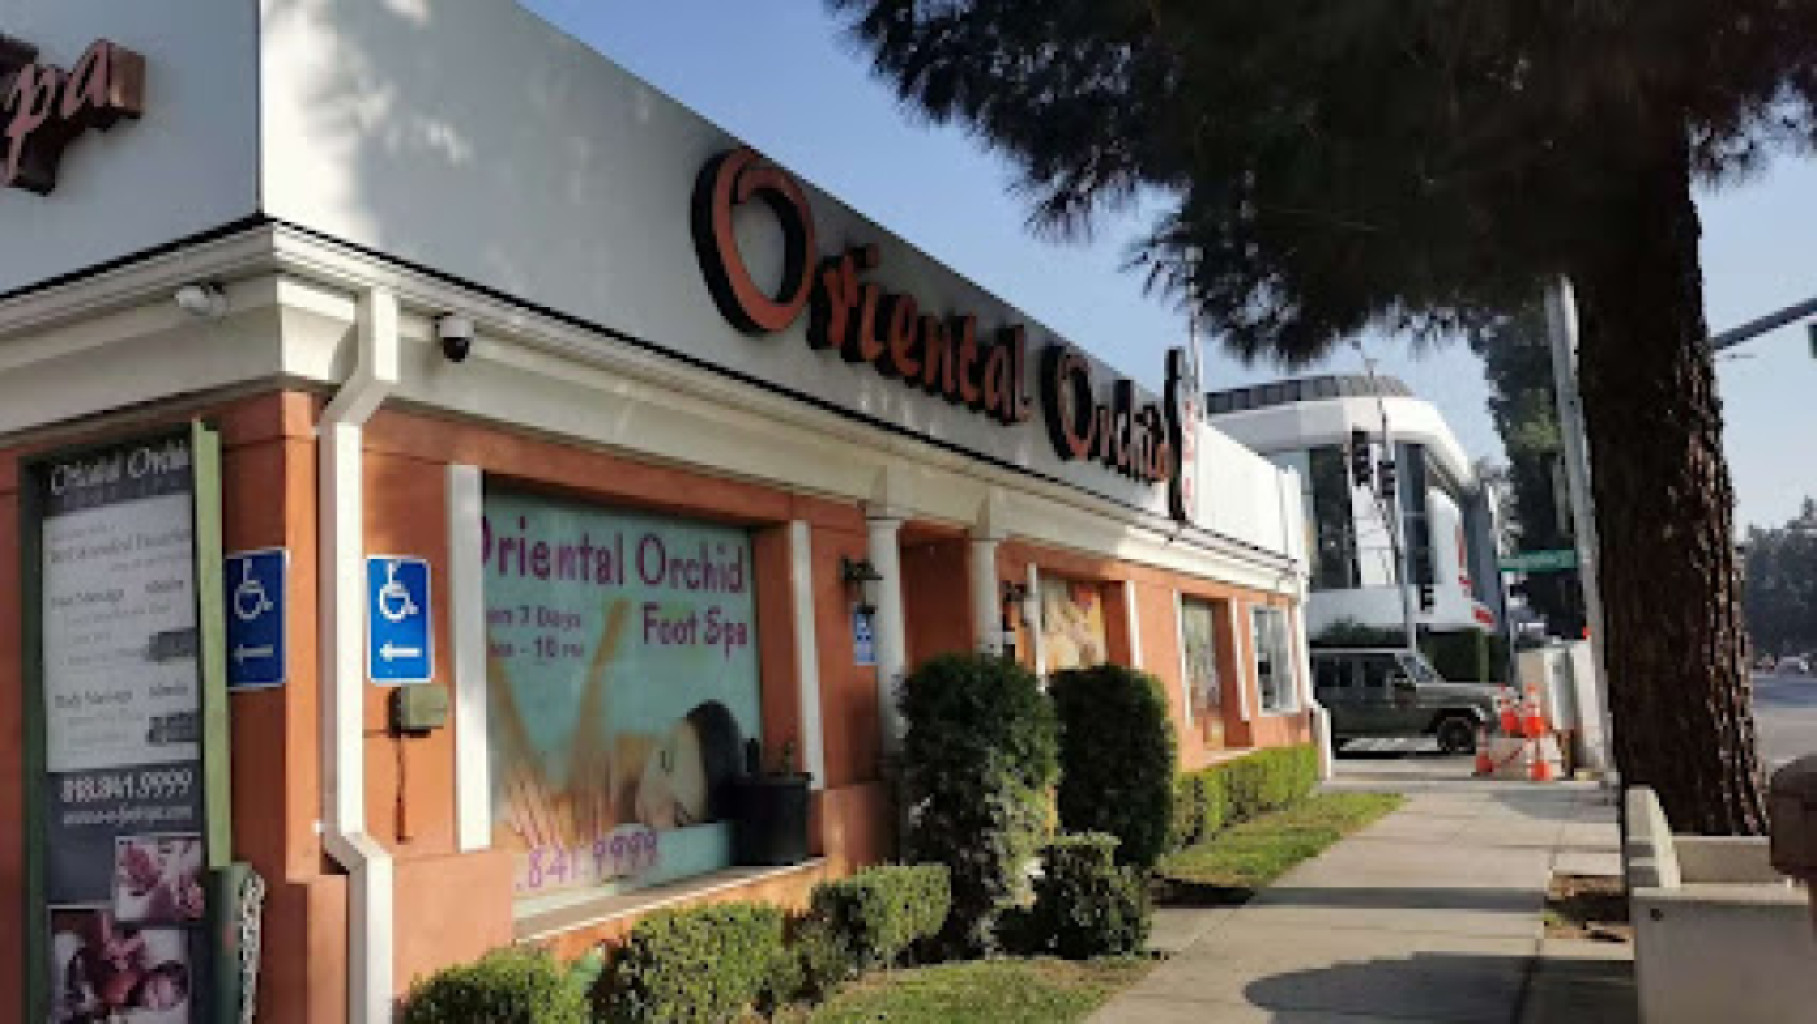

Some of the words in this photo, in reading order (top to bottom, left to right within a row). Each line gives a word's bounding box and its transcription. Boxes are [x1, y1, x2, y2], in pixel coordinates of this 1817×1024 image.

[0, 37, 146, 195] pa
[692, 147, 1033, 426] Oriental
[1040, 344, 1175, 488] Orchid
[635, 532, 745, 594] Orchid
[640, 601, 698, 646] Foot
[703, 606, 748, 661] Spa
